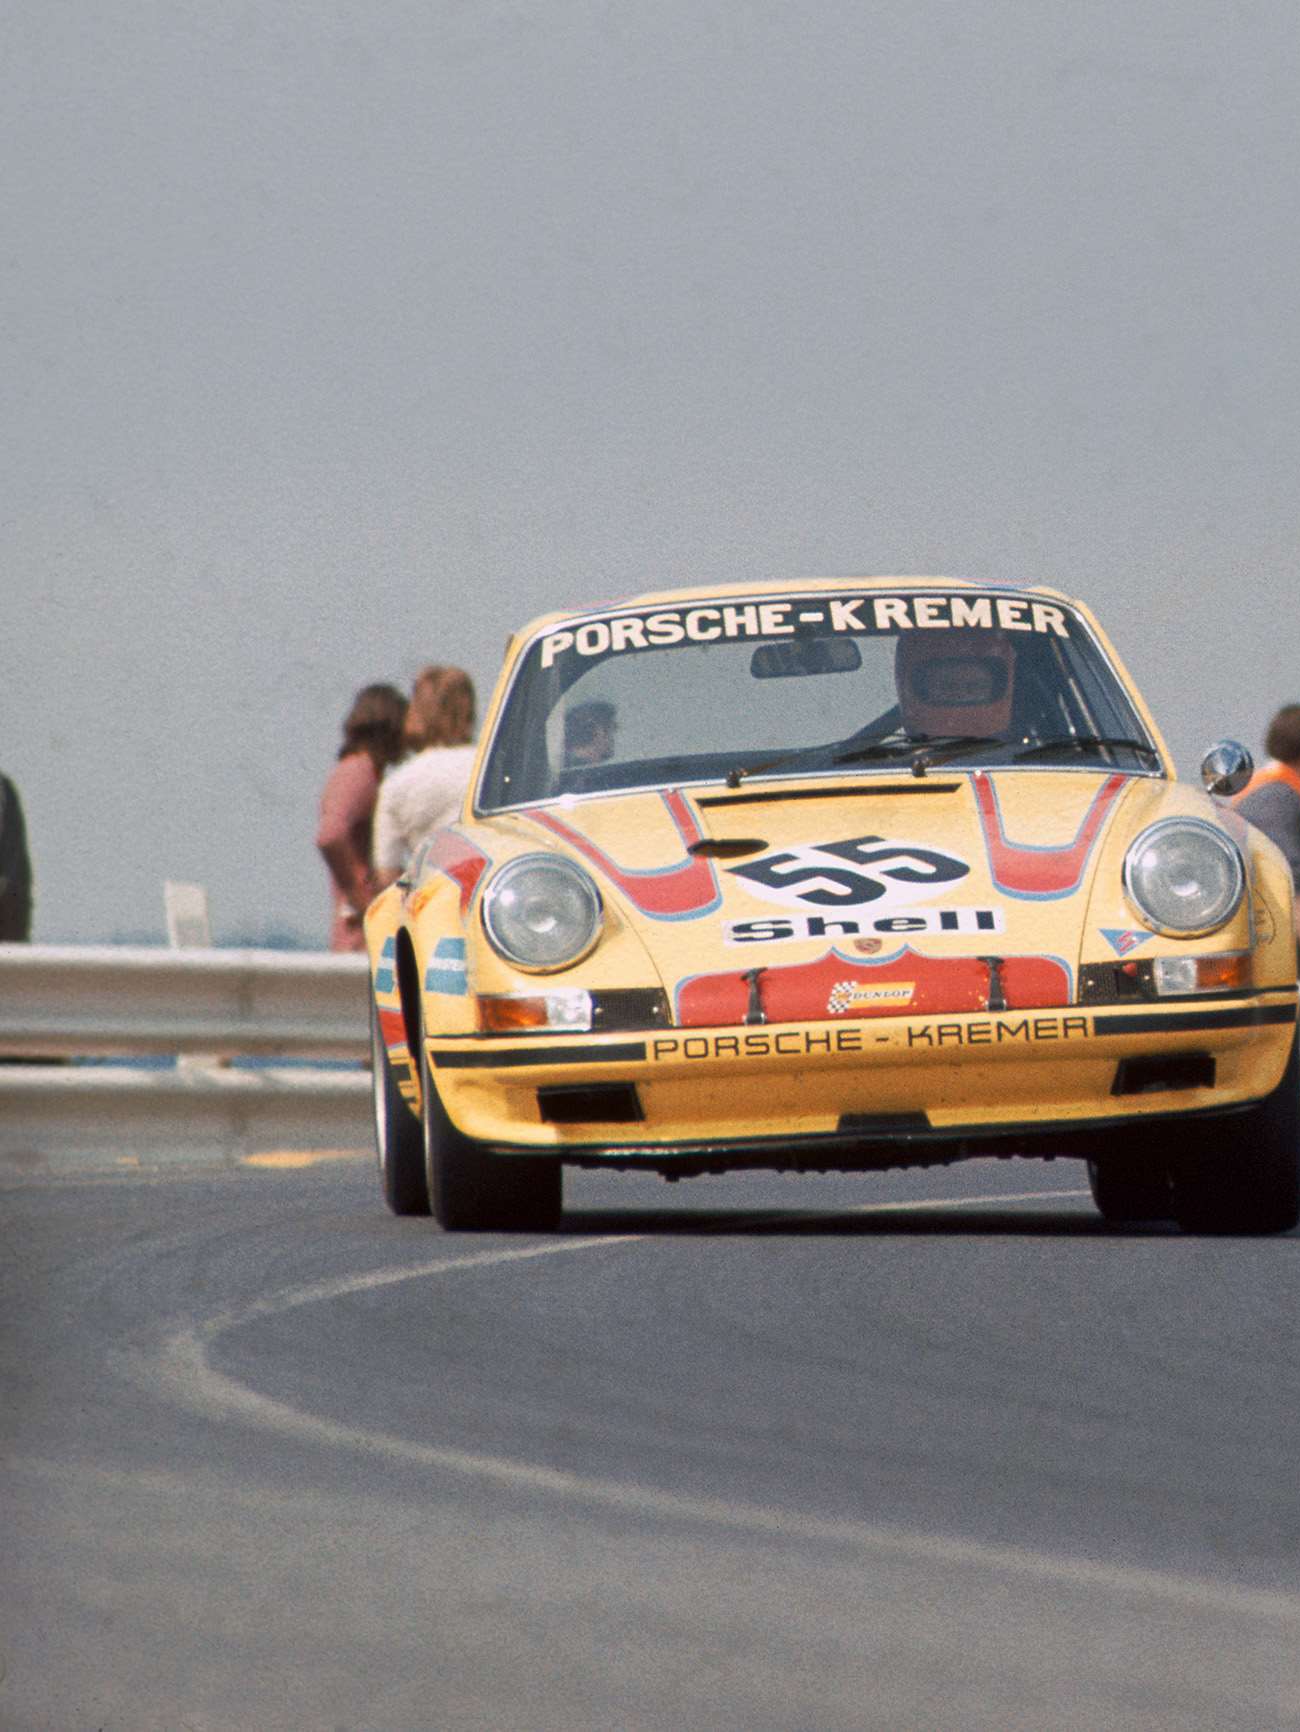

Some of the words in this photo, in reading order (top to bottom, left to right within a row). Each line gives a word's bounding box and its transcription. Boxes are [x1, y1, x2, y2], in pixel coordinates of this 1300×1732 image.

[724, 835, 970, 906] 55
[732, 911, 995, 942] Shell
[853, 990, 911, 1000] DUNLOP
